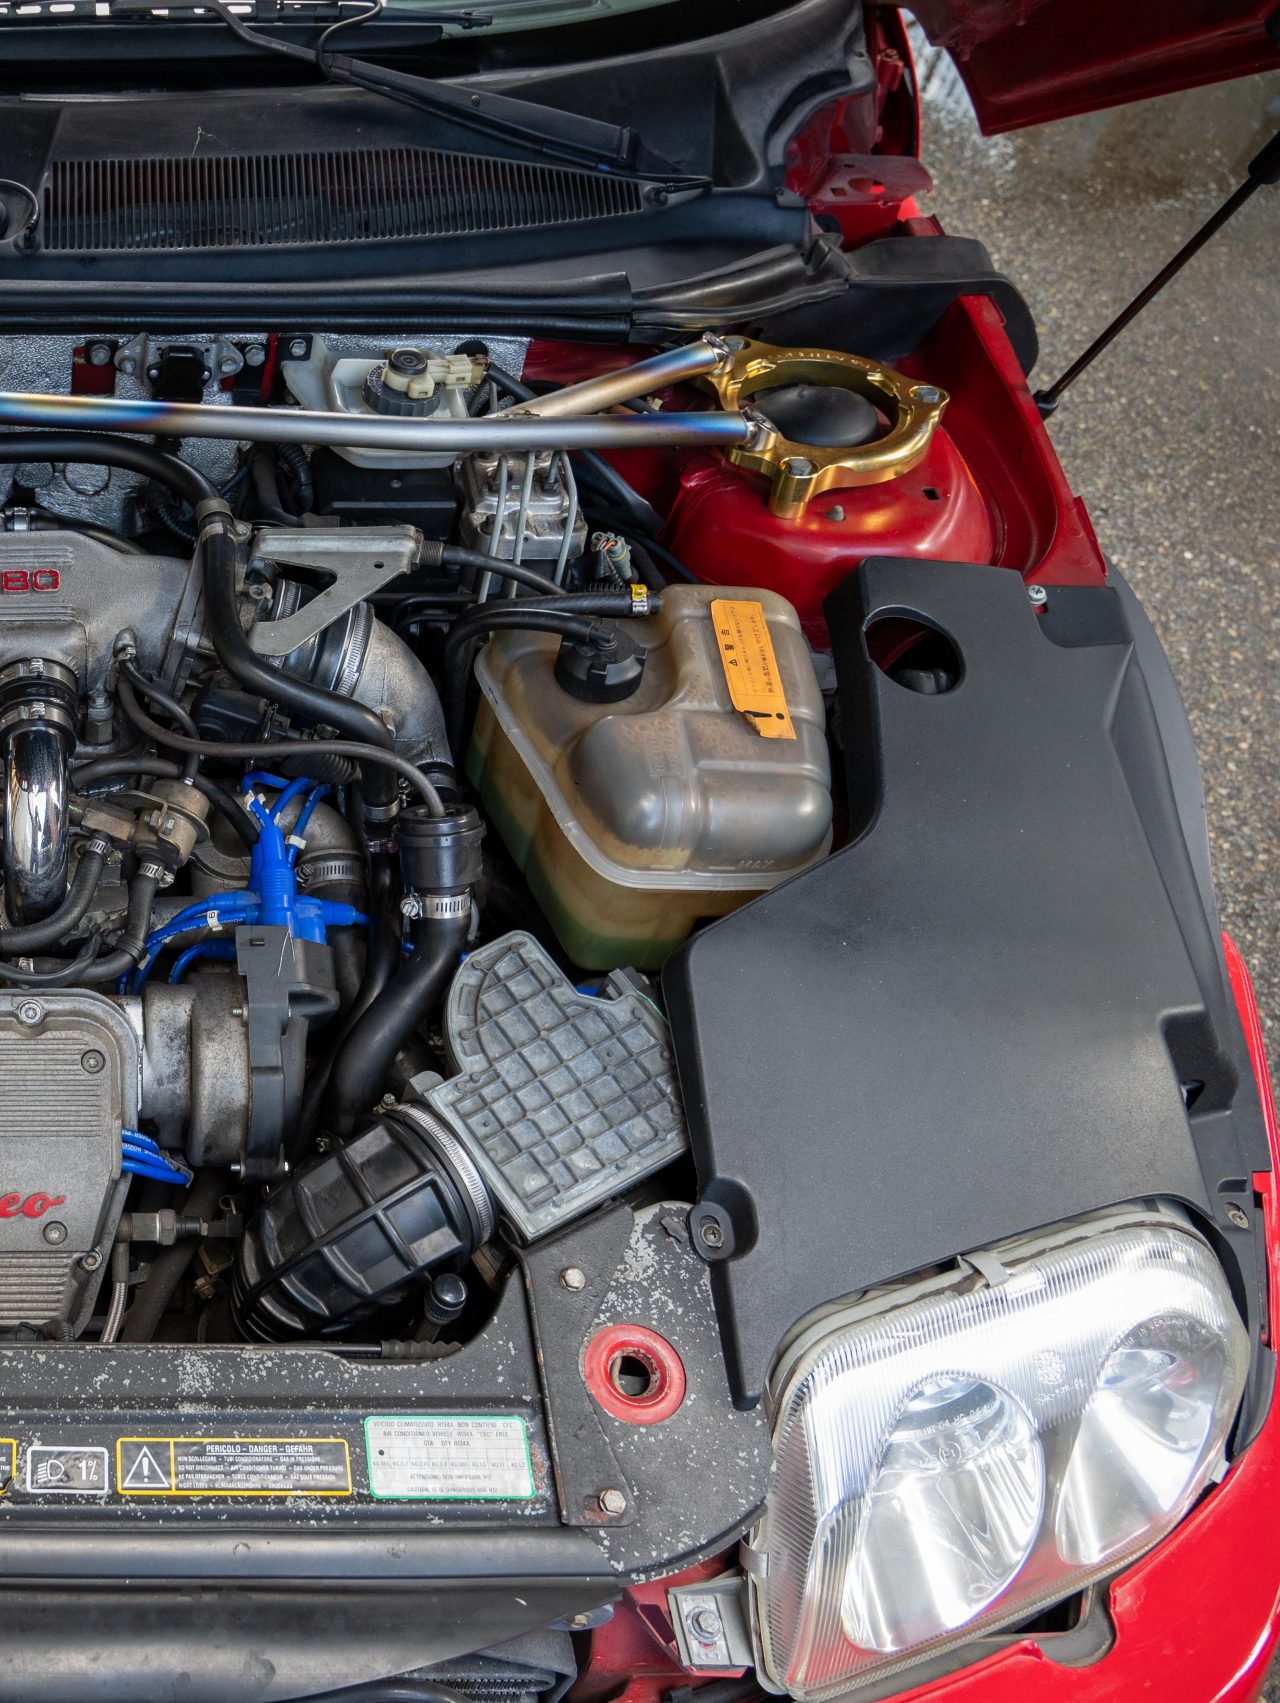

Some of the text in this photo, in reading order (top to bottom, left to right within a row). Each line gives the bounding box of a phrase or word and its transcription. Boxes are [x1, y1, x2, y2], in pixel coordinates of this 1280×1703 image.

[205, 1445, 314, 1453] PERICOLO DANGER GEFAHR
[78, 1459, 98, 1481] 1%
